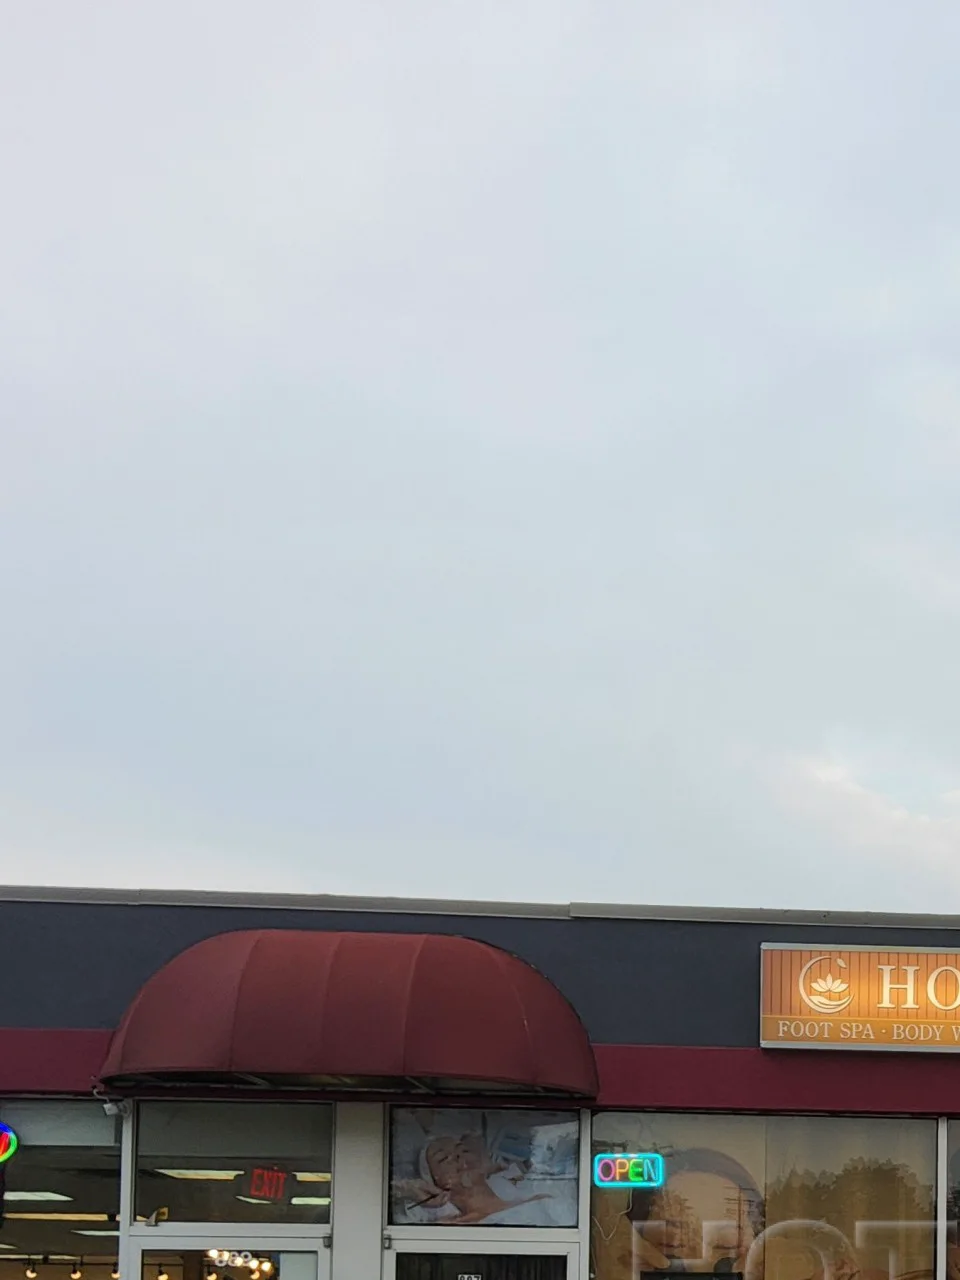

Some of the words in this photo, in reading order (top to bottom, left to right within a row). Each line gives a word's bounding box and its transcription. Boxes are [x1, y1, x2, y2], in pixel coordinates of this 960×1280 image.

[777, 1020, 833, 1038] FOOT
[839, 1022, 875, 1040] SPA
[891, 1023, 944, 1042] BODY
[598, 1158, 659, 1182] OPEN
[250, 1168, 287, 1200] EXIT
